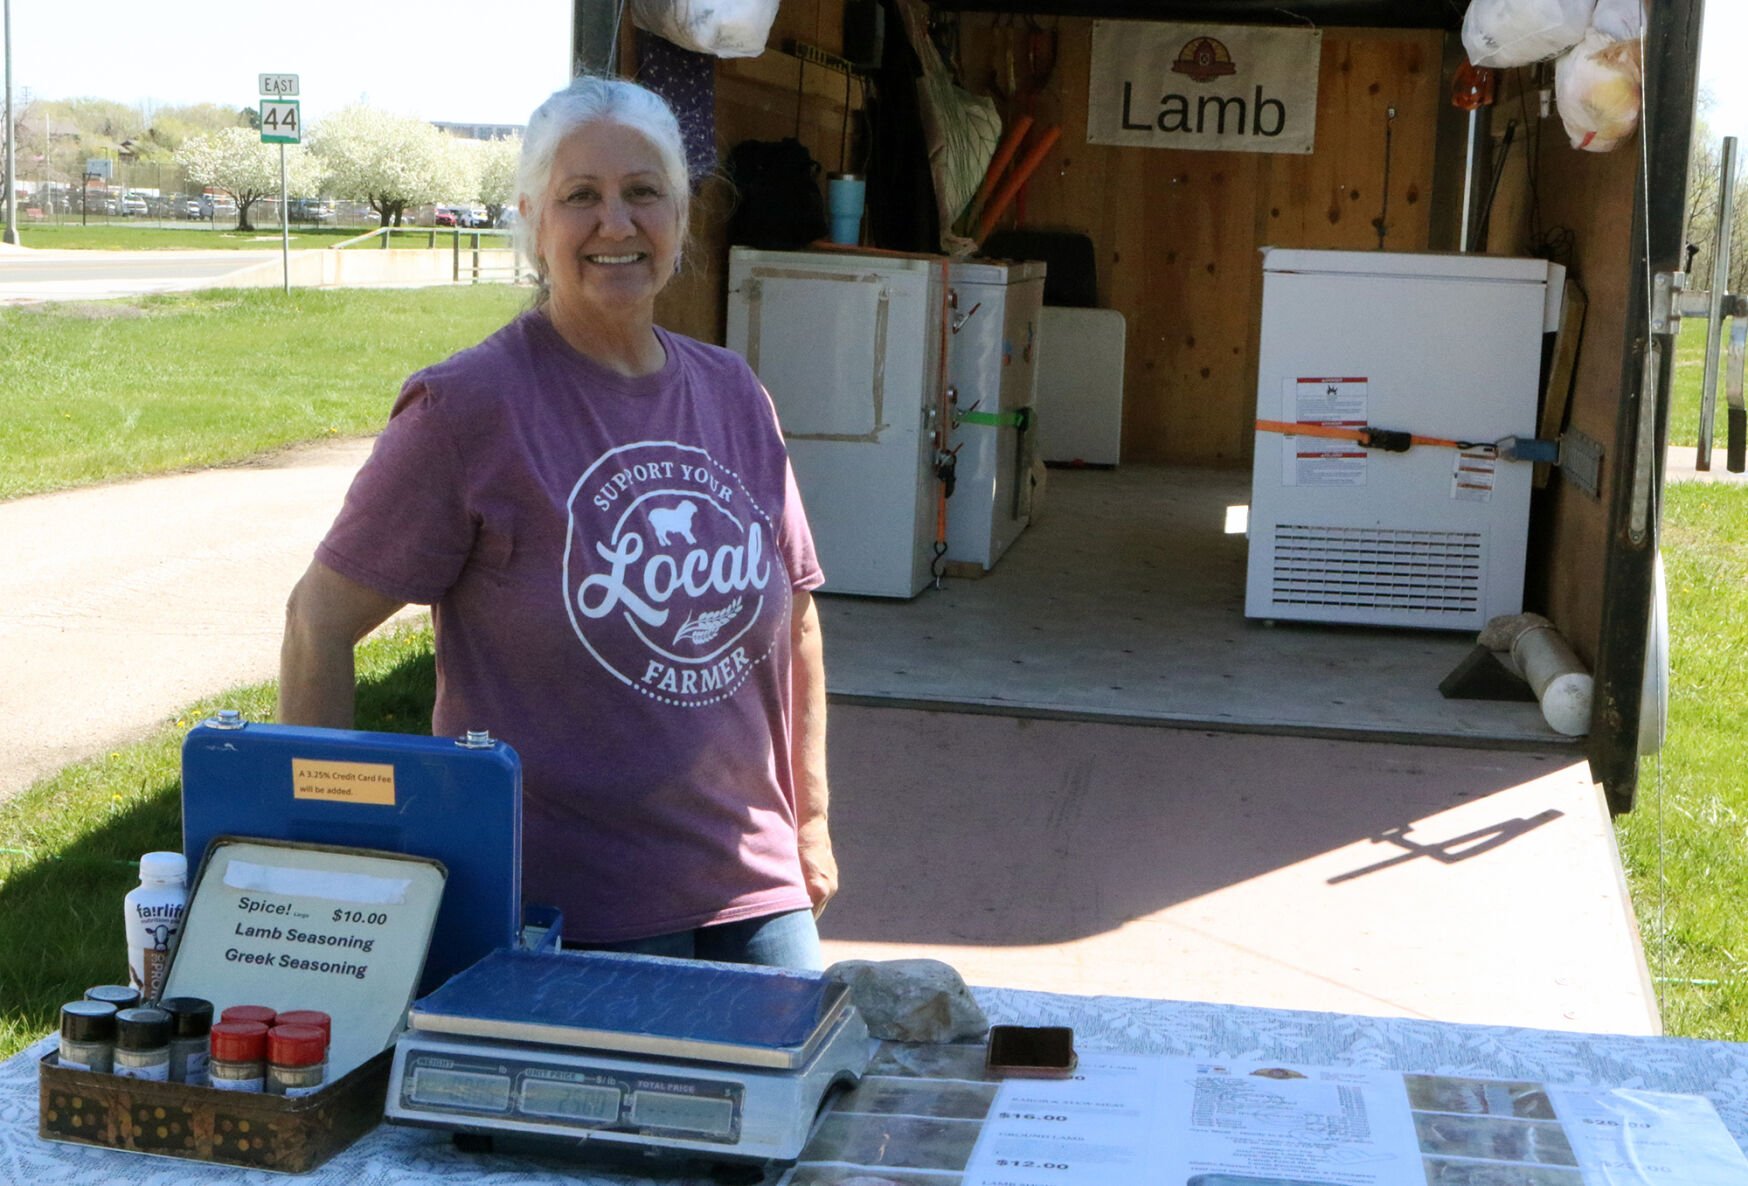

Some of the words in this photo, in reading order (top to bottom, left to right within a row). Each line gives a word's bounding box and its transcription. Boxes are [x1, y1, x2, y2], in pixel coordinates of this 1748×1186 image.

[264, 77, 294, 92] EAST
[263, 107, 297, 131] 44
[1121, 81, 1286, 137] Lamb
[593, 461, 674, 512] SUPPORT
[681, 464, 733, 502] YOUR
[577, 522, 770, 627] Local
[640, 646, 750, 694] FARMER
[307, 770, 331, 779] 3.25%
[332, 772, 356, 781] Credit
[357, 774, 376, 782] Card
[377, 775, 392, 783] Fee
[315, 786, 325, 794] be
[326, 787, 353, 796] added.
[238, 897, 292, 916] Spice!
[332, 908, 388, 926] $10.00
[235, 922, 282, 940] Lamb
[286, 928, 375, 953] Seasoning
[225, 948, 276, 966] Greek
[278, 954, 369, 980] Seasoning
[638, 1080, 665, 1091] TOTAL
[667, 1083, 696, 1093] PRICE
[999, 1112, 1068, 1122] $16.00
[995, 1159, 1069, 1170] $12.00
